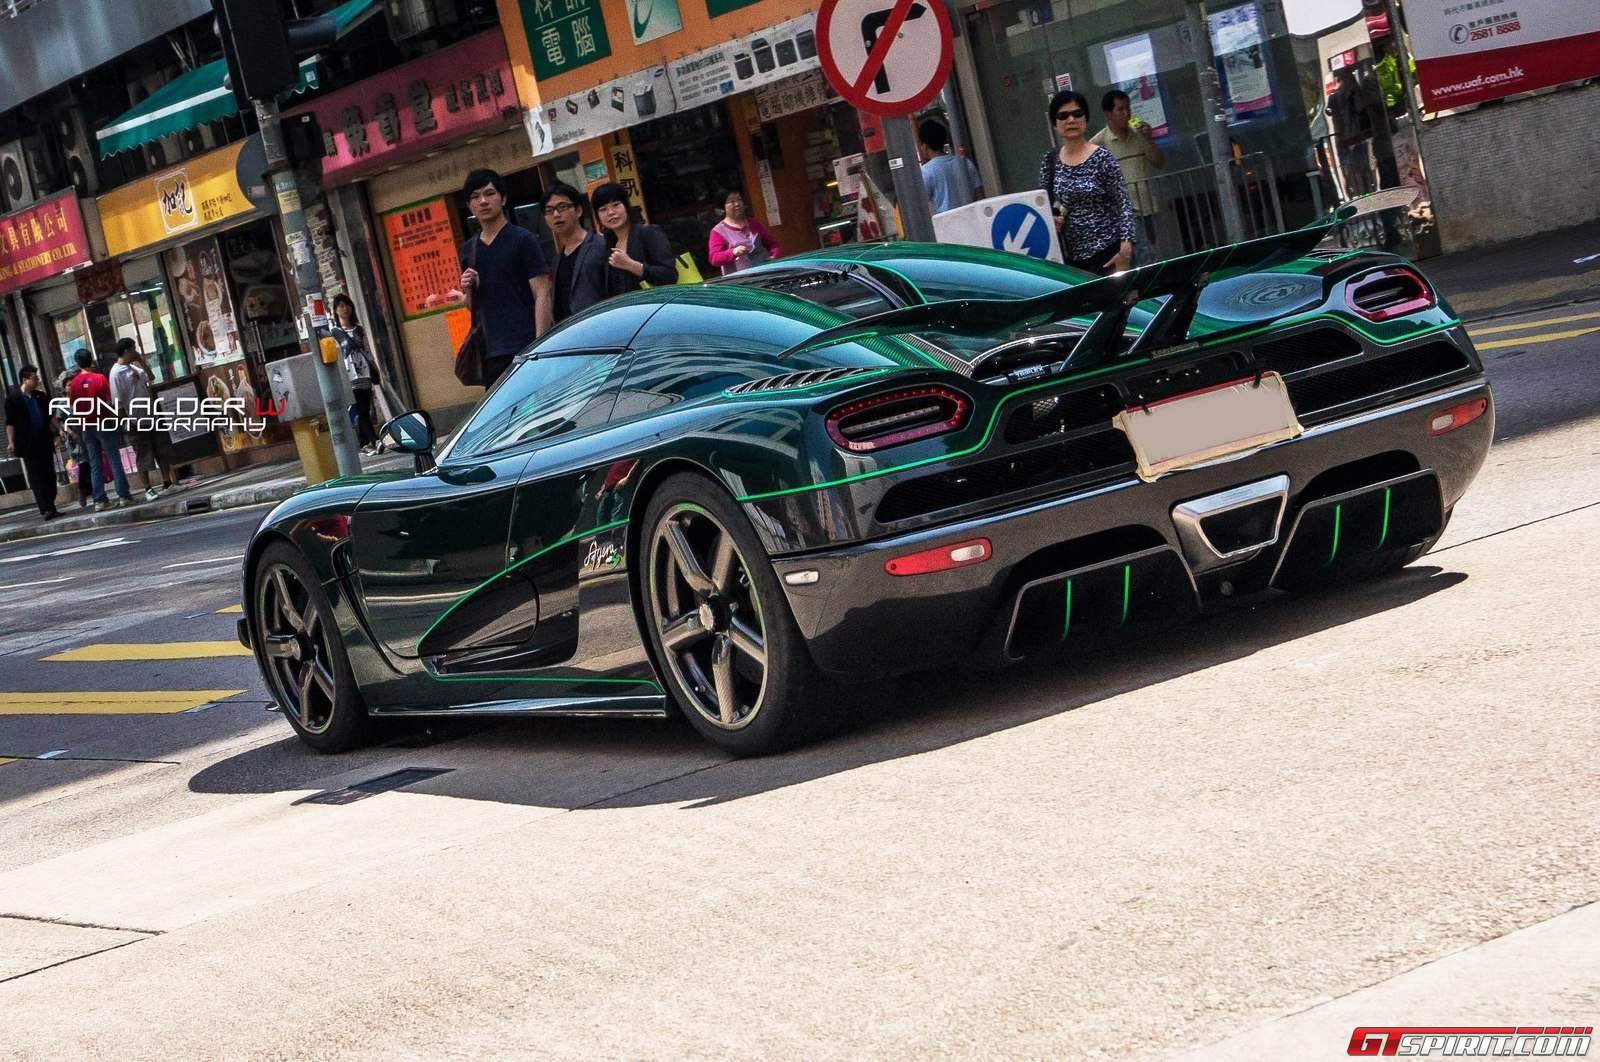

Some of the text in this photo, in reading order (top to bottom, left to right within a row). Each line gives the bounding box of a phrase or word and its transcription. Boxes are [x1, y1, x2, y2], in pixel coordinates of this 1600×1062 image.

[541, 15, 596, 66] 電腦
[1470, 21, 1521, 41] 2681 8888
[1431, 66, 1524, 96] www.uaf.com.hk
